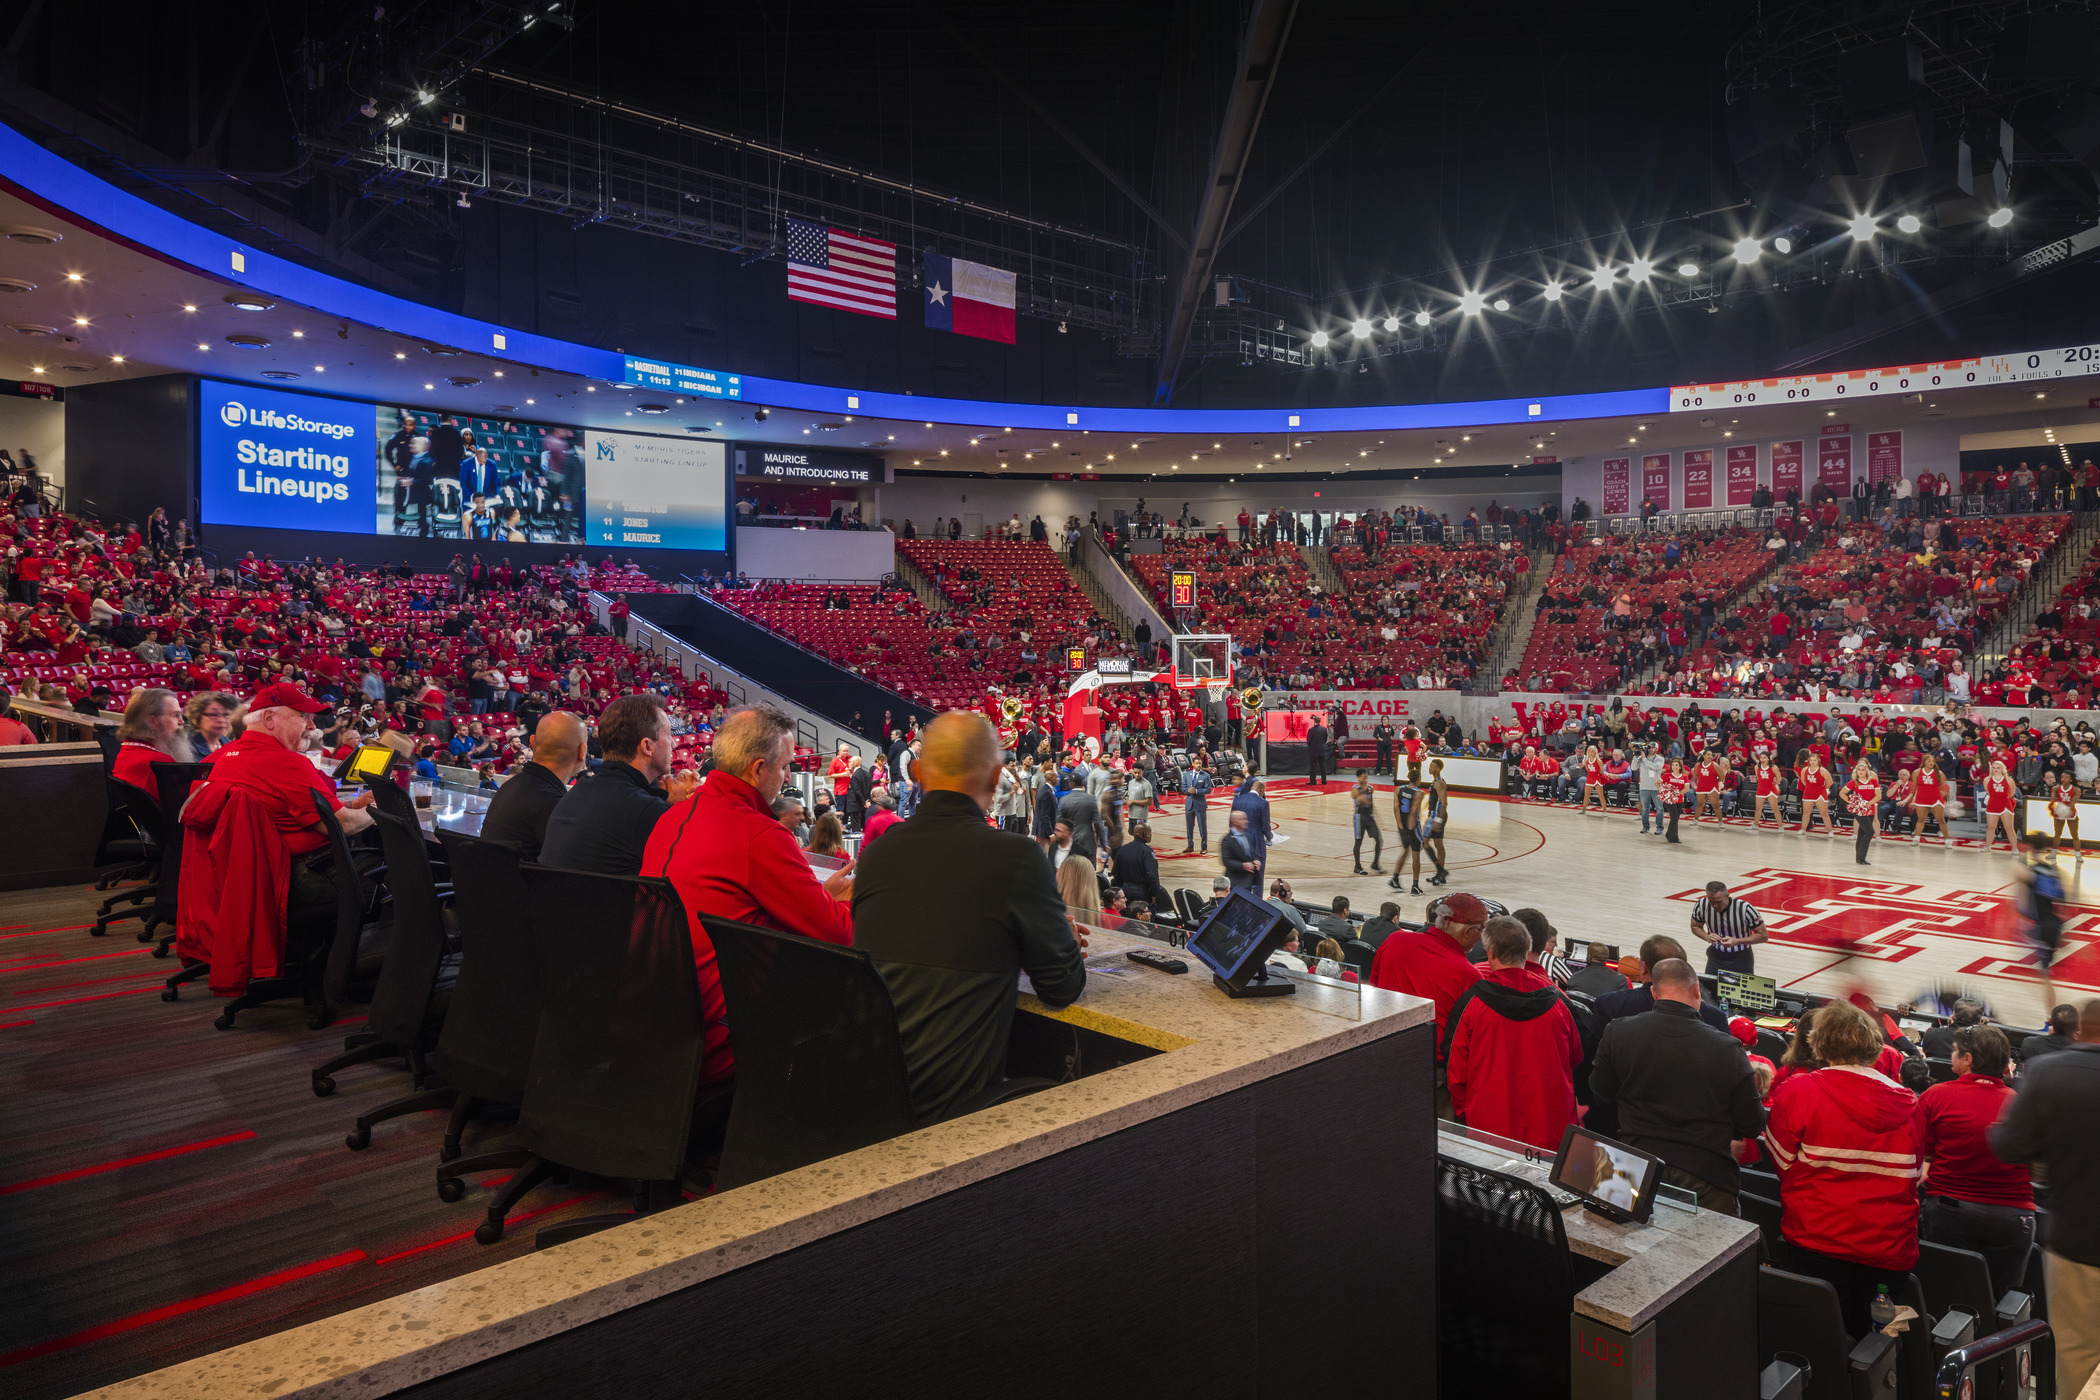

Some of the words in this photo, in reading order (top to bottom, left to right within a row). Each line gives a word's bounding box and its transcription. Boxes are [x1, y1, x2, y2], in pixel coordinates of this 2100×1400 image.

[2027, 354, 2040, 368] 0
[683, 368, 716, 381] INDIANA
[1932, 375, 1941, 385] 0
[1966, 372, 1975, 382] 0
[684, 381, 722, 394] MICHIGAN
[1837, 385, 1845, 394] 0
[1869, 382, 1878, 391] 0
[1900, 379, 1909, 388] 0
[634, 444, 674, 453] MEMPHIS
[677, 448, 706, 456] TIGERS
[237, 439, 349, 478] Starting
[634, 456, 675, 466] STARTING
[678, 460, 708, 468] LINEUP
[764, 453, 809, 465] MAURICE.
[1823, 458, 1846, 470] 44
[764, 466, 784, 475] AND
[786, 467, 849, 479] INTRODUCING
[851, 471, 869, 480] THE
[1731, 466, 1751, 477] 34
[1776, 462, 1797, 474] 42
[1648, 474, 1664, 485] 10
[1688, 470, 1707, 481] 22
[238, 468, 349, 504] Lineups
[603, 518, 612, 526] 11
[622, 518, 649, 528] JONES
[603, 533, 613, 541] 14
[623, 532, 661, 543] MAURICE
[1174, 575, 1191, 585] 20:00
[1176, 586, 1190, 603] 30
[1070, 651, 1083, 659] 20:00
[1072, 659, 1081, 669] 30
[1342, 700, 1409, 715] CAGE
[1400, 798, 1410, 813] 3
[1169, 930, 1185, 949] 01
[1525, 1148, 1541, 1164] 01
[1580, 1331, 1622, 1367] L03
